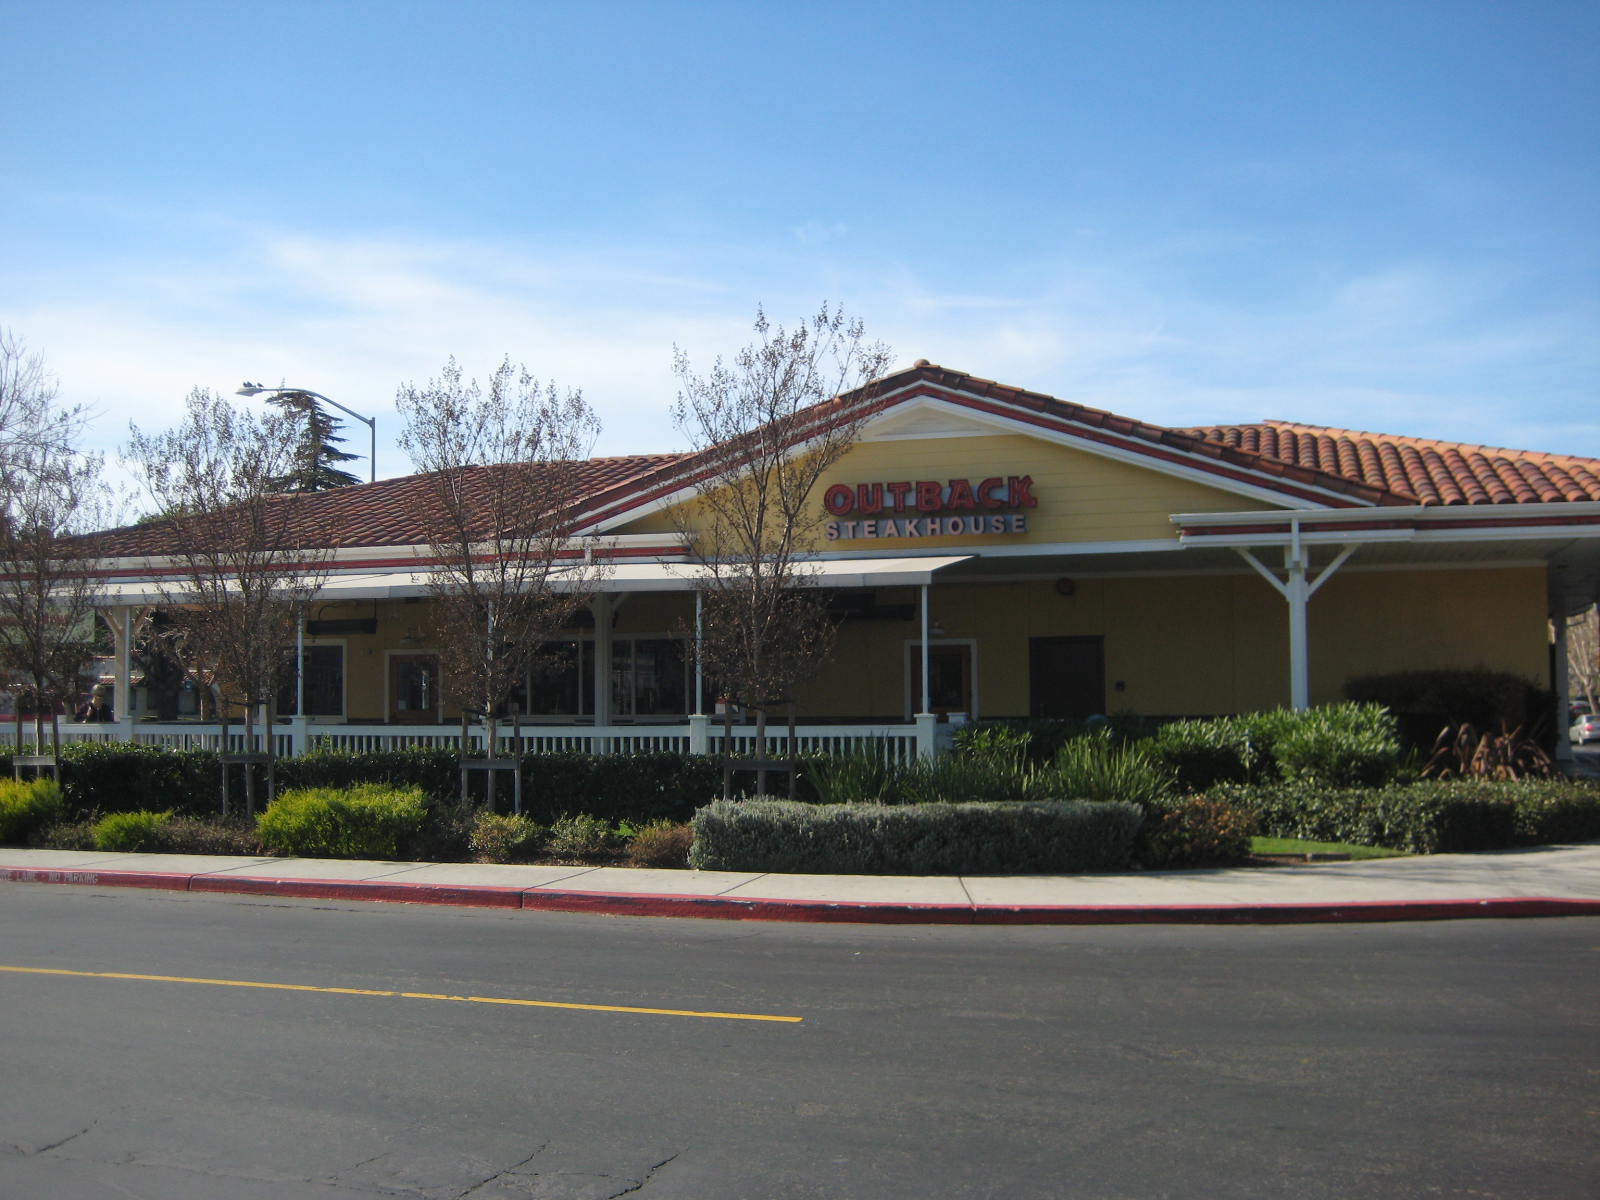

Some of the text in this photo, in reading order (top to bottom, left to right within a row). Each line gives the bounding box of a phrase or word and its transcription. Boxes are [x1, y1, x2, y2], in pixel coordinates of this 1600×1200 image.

[824, 475, 1038, 516] OUTBACK
[826, 515, 1026, 541] STEAKHOUSE
[48, 871, 60, 882] NO
[64, 872, 98, 884] PARKING
